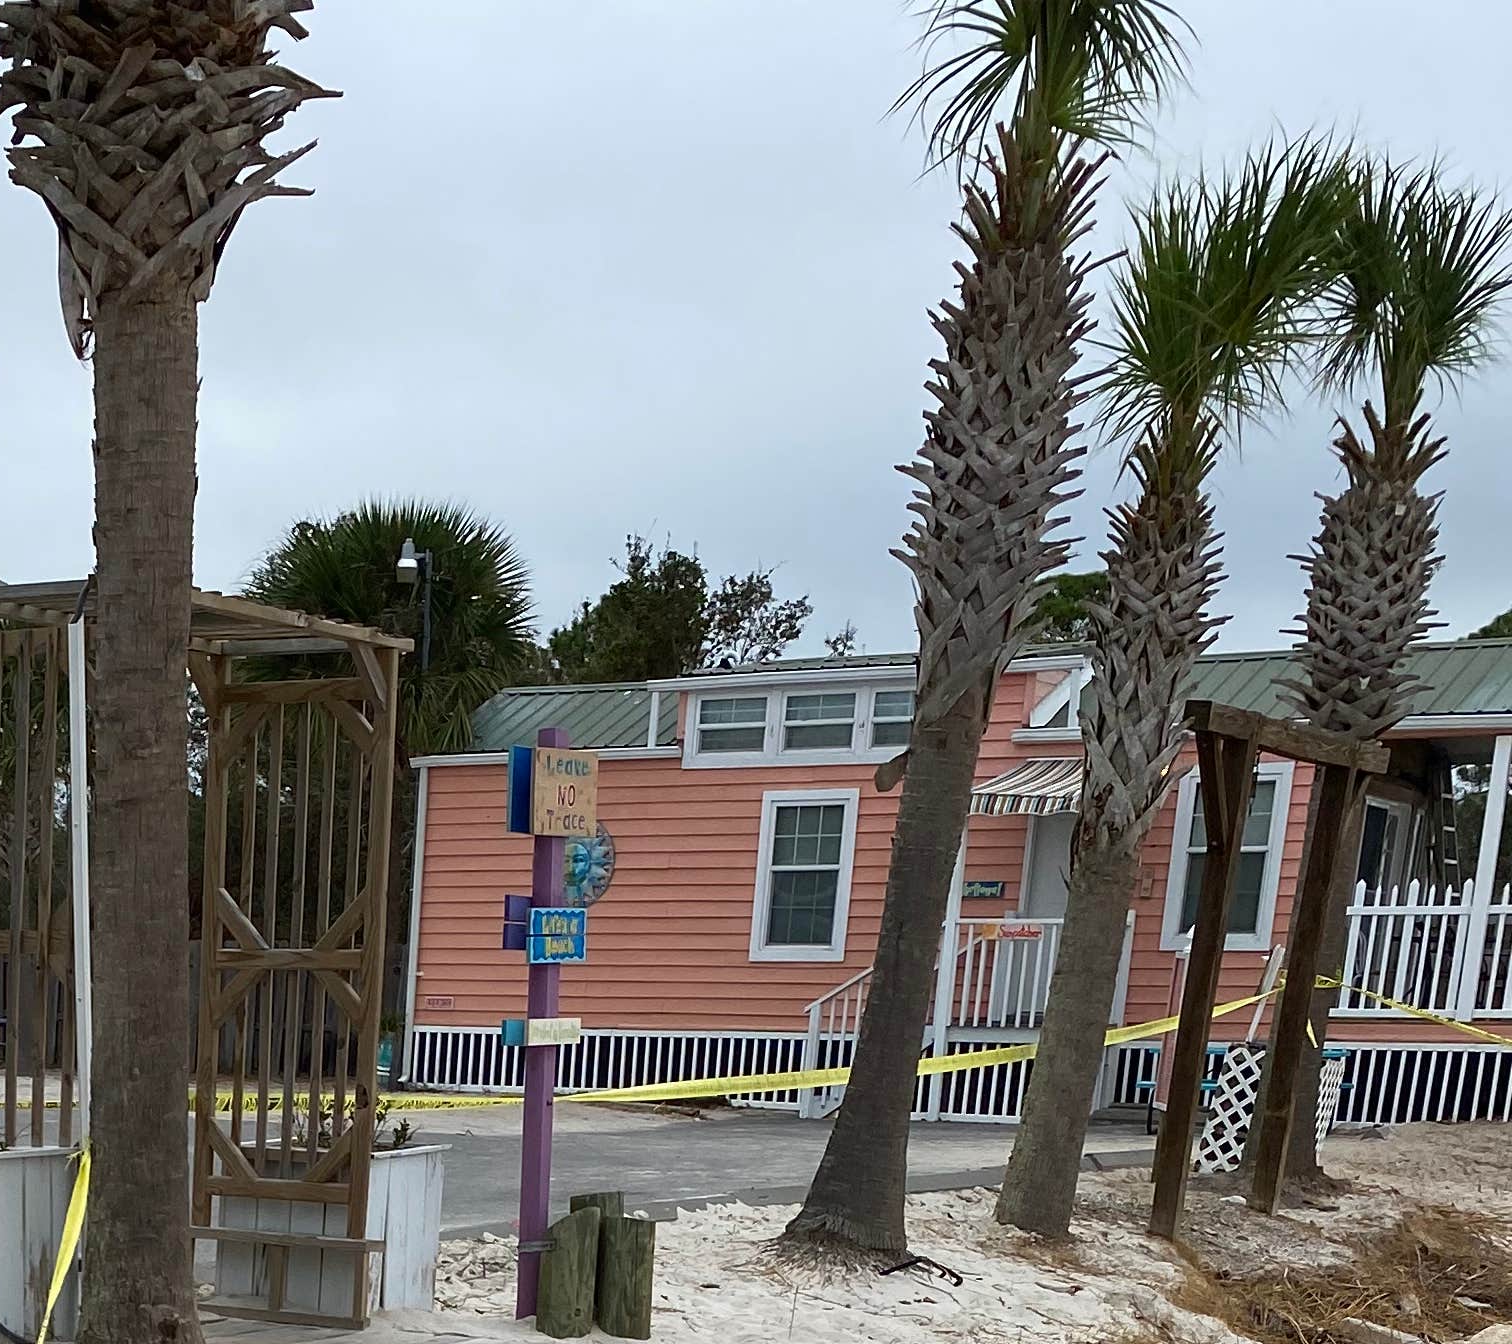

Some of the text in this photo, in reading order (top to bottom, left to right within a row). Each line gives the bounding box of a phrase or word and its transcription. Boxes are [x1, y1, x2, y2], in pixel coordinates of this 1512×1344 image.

[545, 755, 589, 776] Leave
[557, 785, 576, 807] NO
[546, 809, 586, 830] Trace
